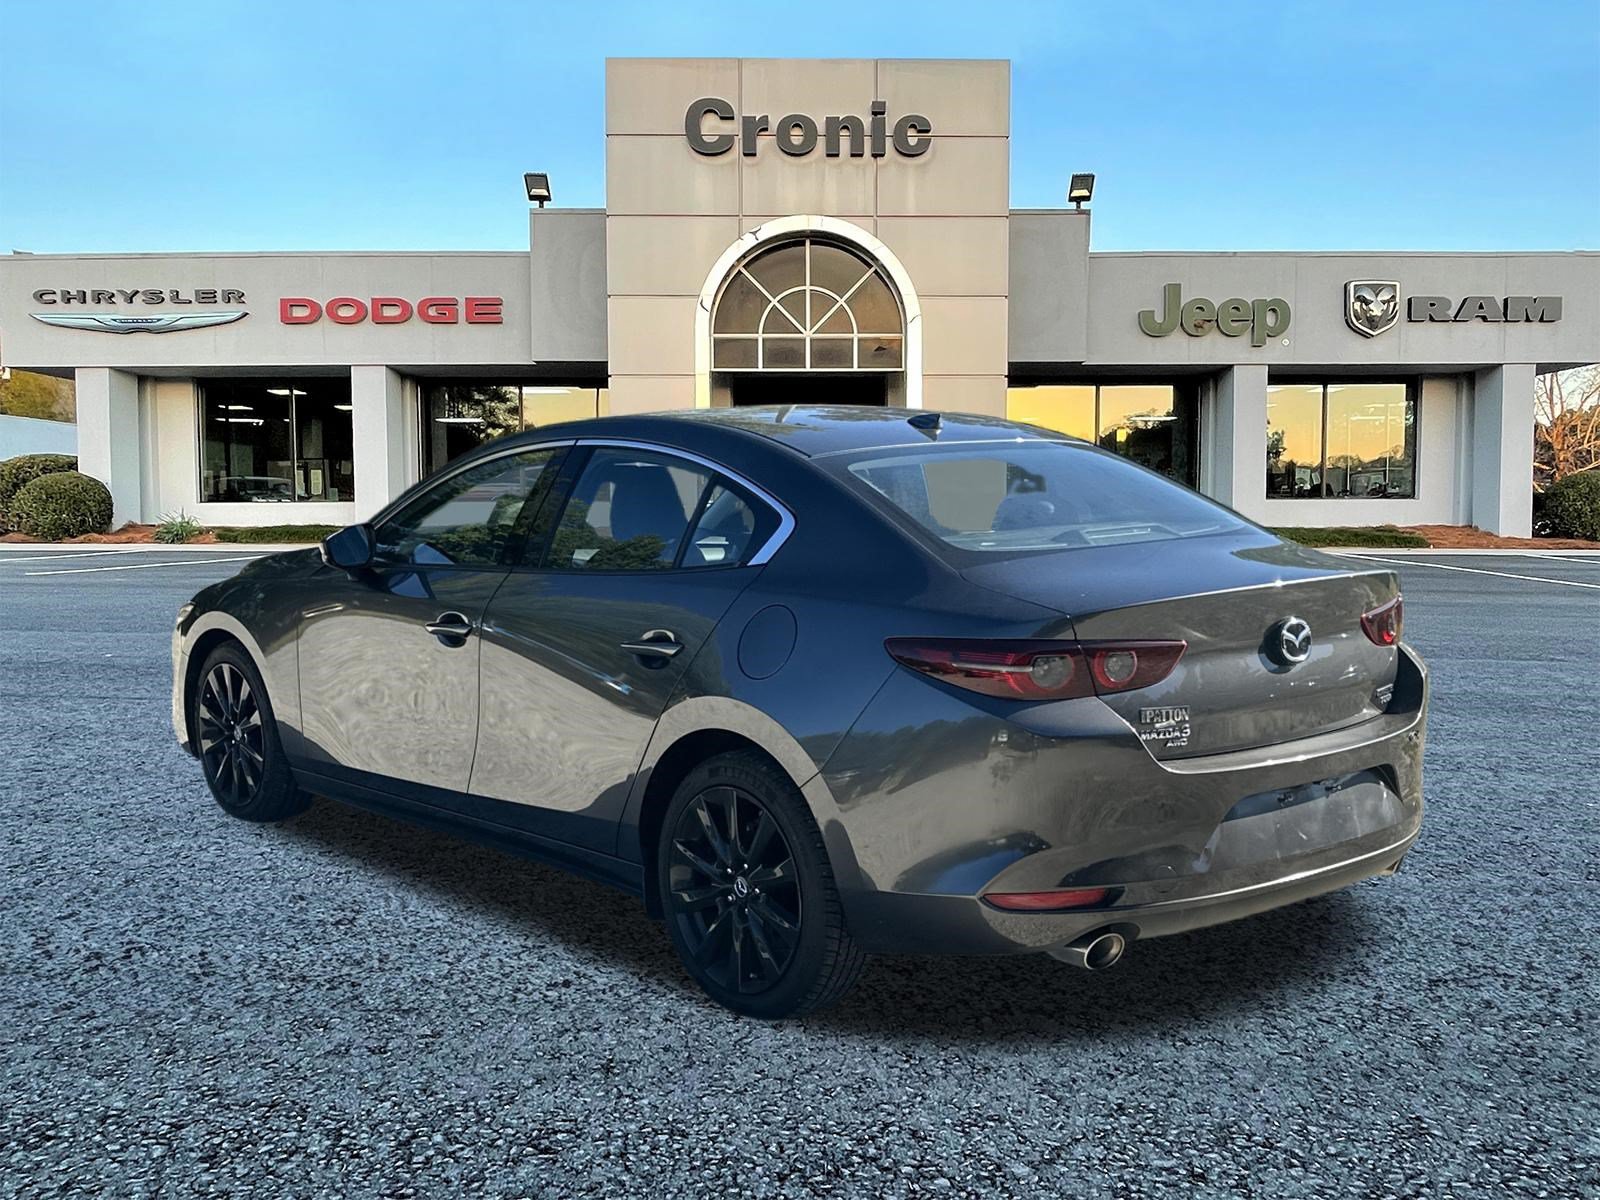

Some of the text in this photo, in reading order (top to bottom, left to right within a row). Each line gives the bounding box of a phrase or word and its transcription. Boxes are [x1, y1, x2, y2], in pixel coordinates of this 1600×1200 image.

[685, 97, 932, 157] Cronic
[32, 289, 246, 304] CHRYSLER
[1407, 296, 1562, 322] RAM
[279, 297, 503, 324] DODGE
[1138, 283, 1291, 347] Jeep
